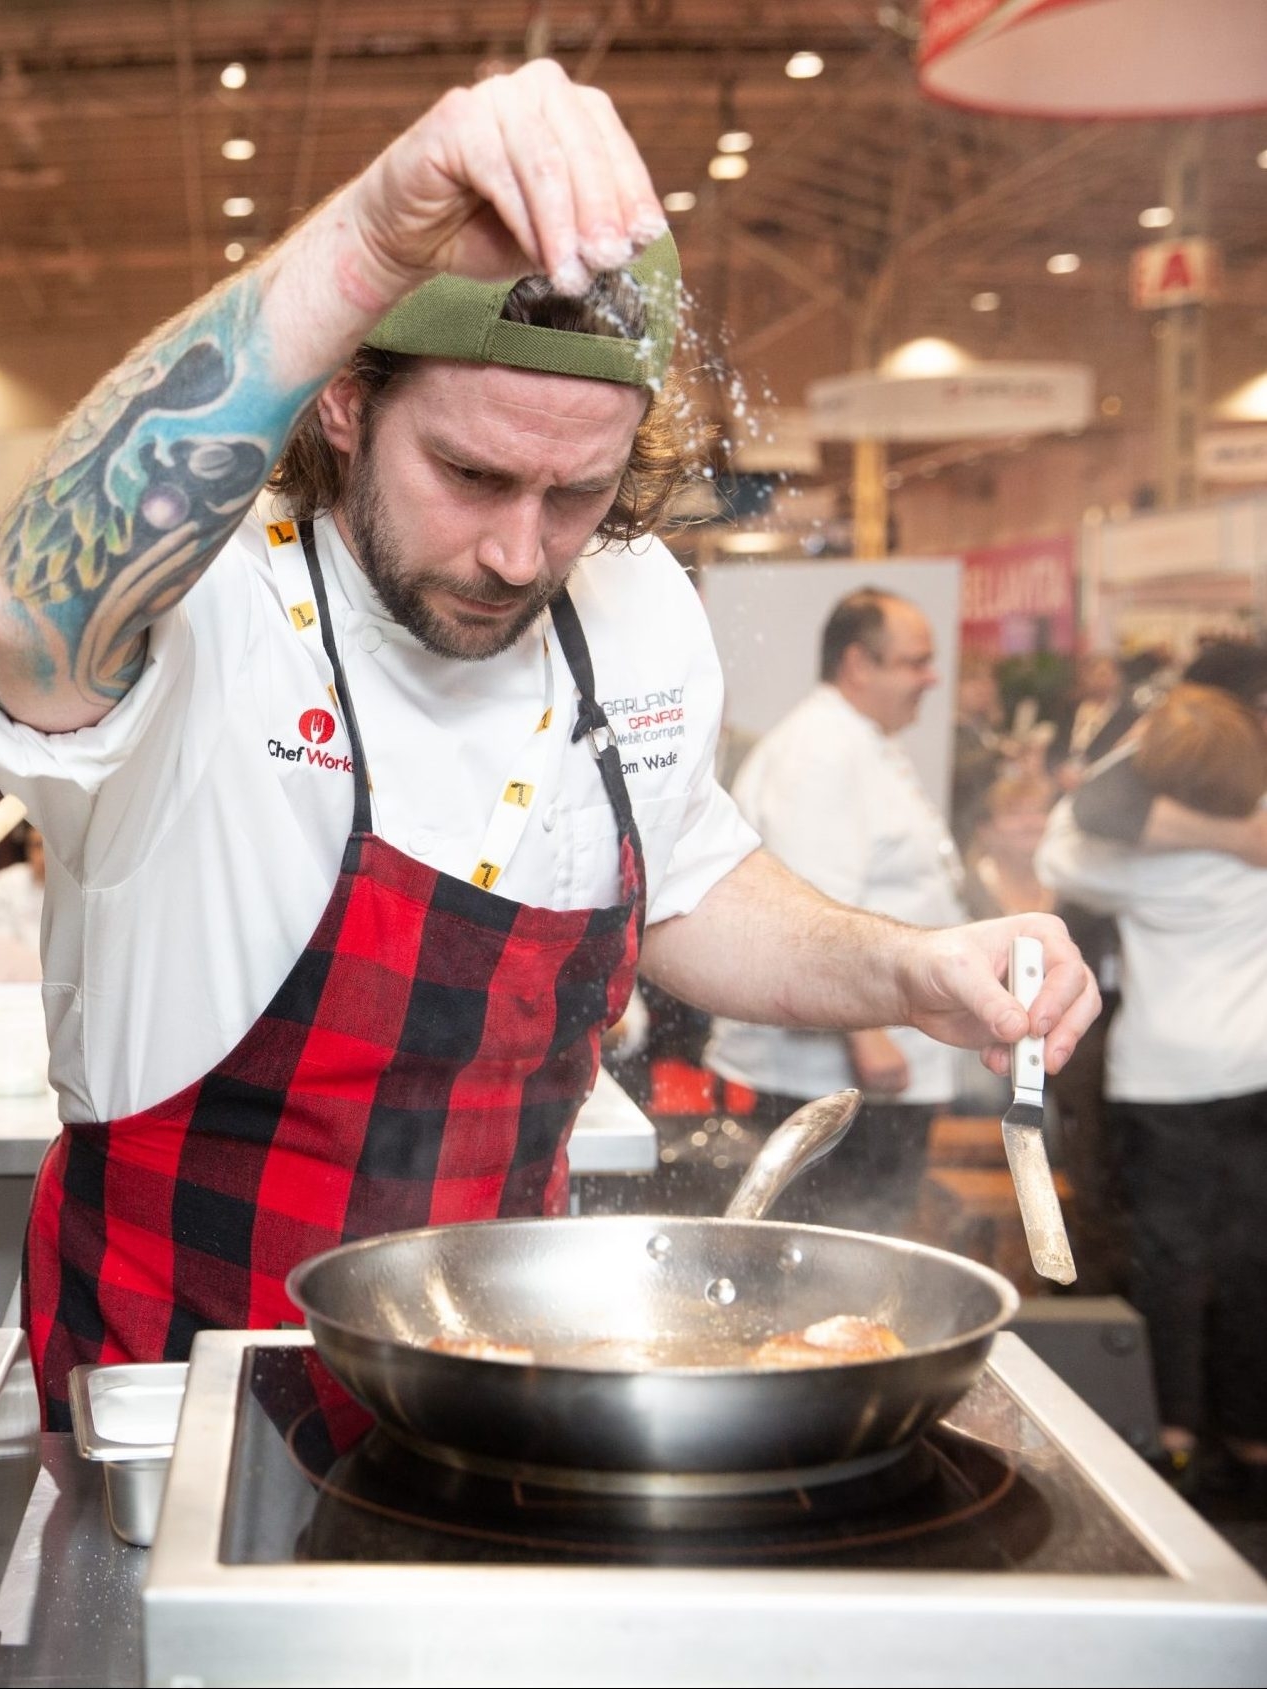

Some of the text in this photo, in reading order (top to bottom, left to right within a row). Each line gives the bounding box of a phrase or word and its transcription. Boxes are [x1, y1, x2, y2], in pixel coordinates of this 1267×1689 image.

[1160, 249, 1192, 290] A
[268, 739, 305, 762] Chef
[642, 751, 677, 770] Wade
